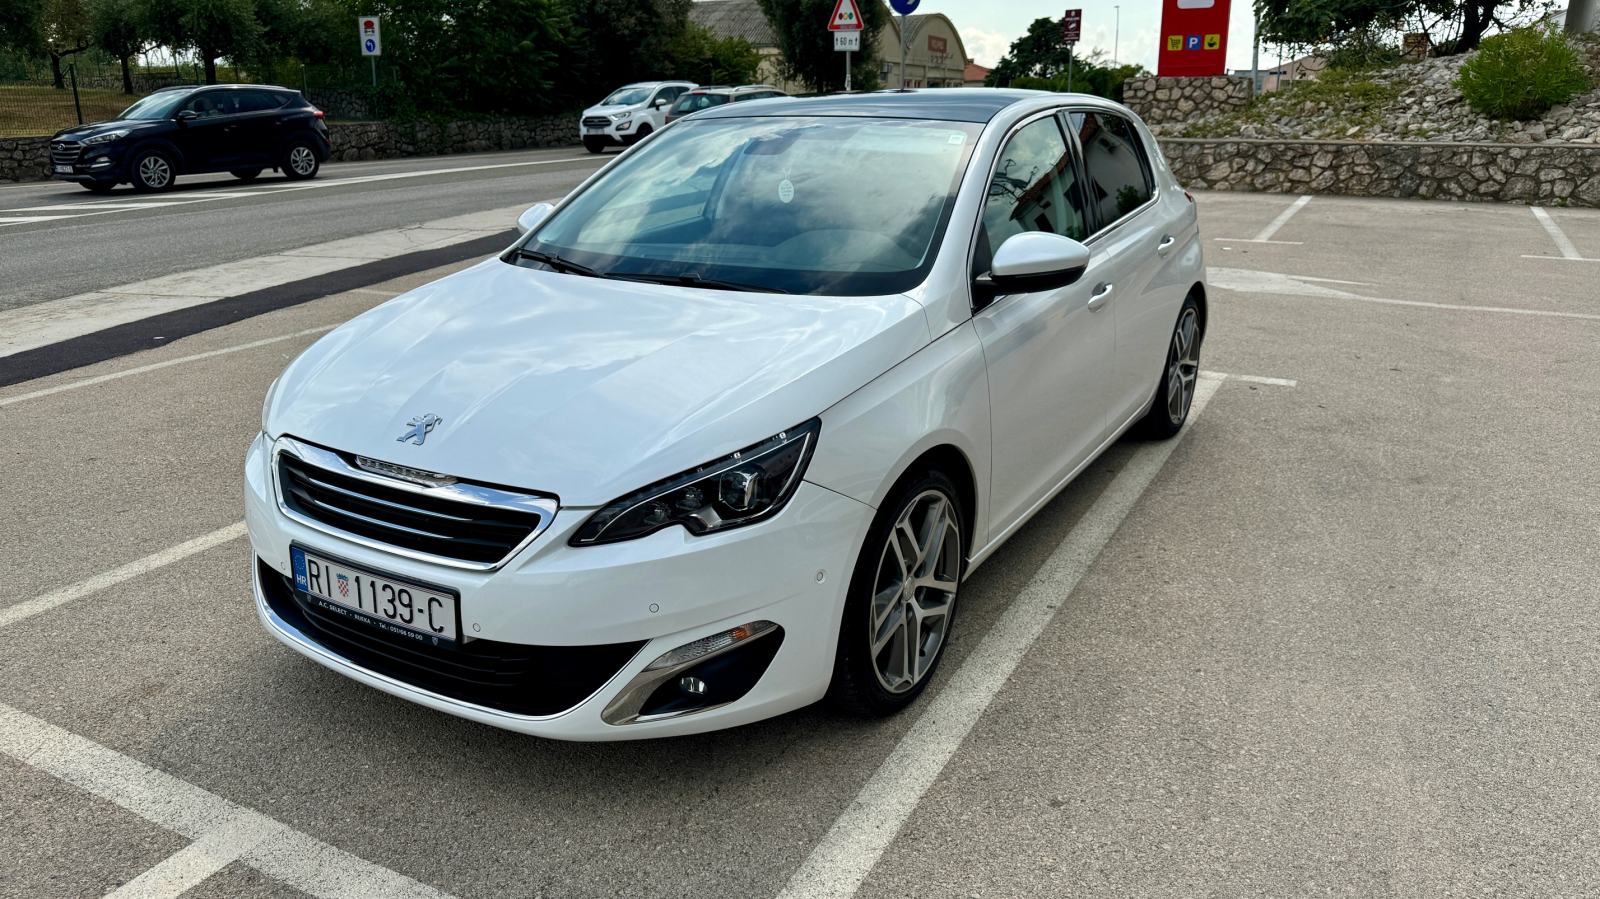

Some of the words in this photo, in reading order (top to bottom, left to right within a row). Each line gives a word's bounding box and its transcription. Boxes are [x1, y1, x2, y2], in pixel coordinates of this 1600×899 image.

[1188, 37, 1198, 48] P
[296, 573, 307, 587] HR
[307, 559, 332, 597] RI
[355, 576, 444, 633] 1139-C
[329, 604, 347, 615] SELECT
